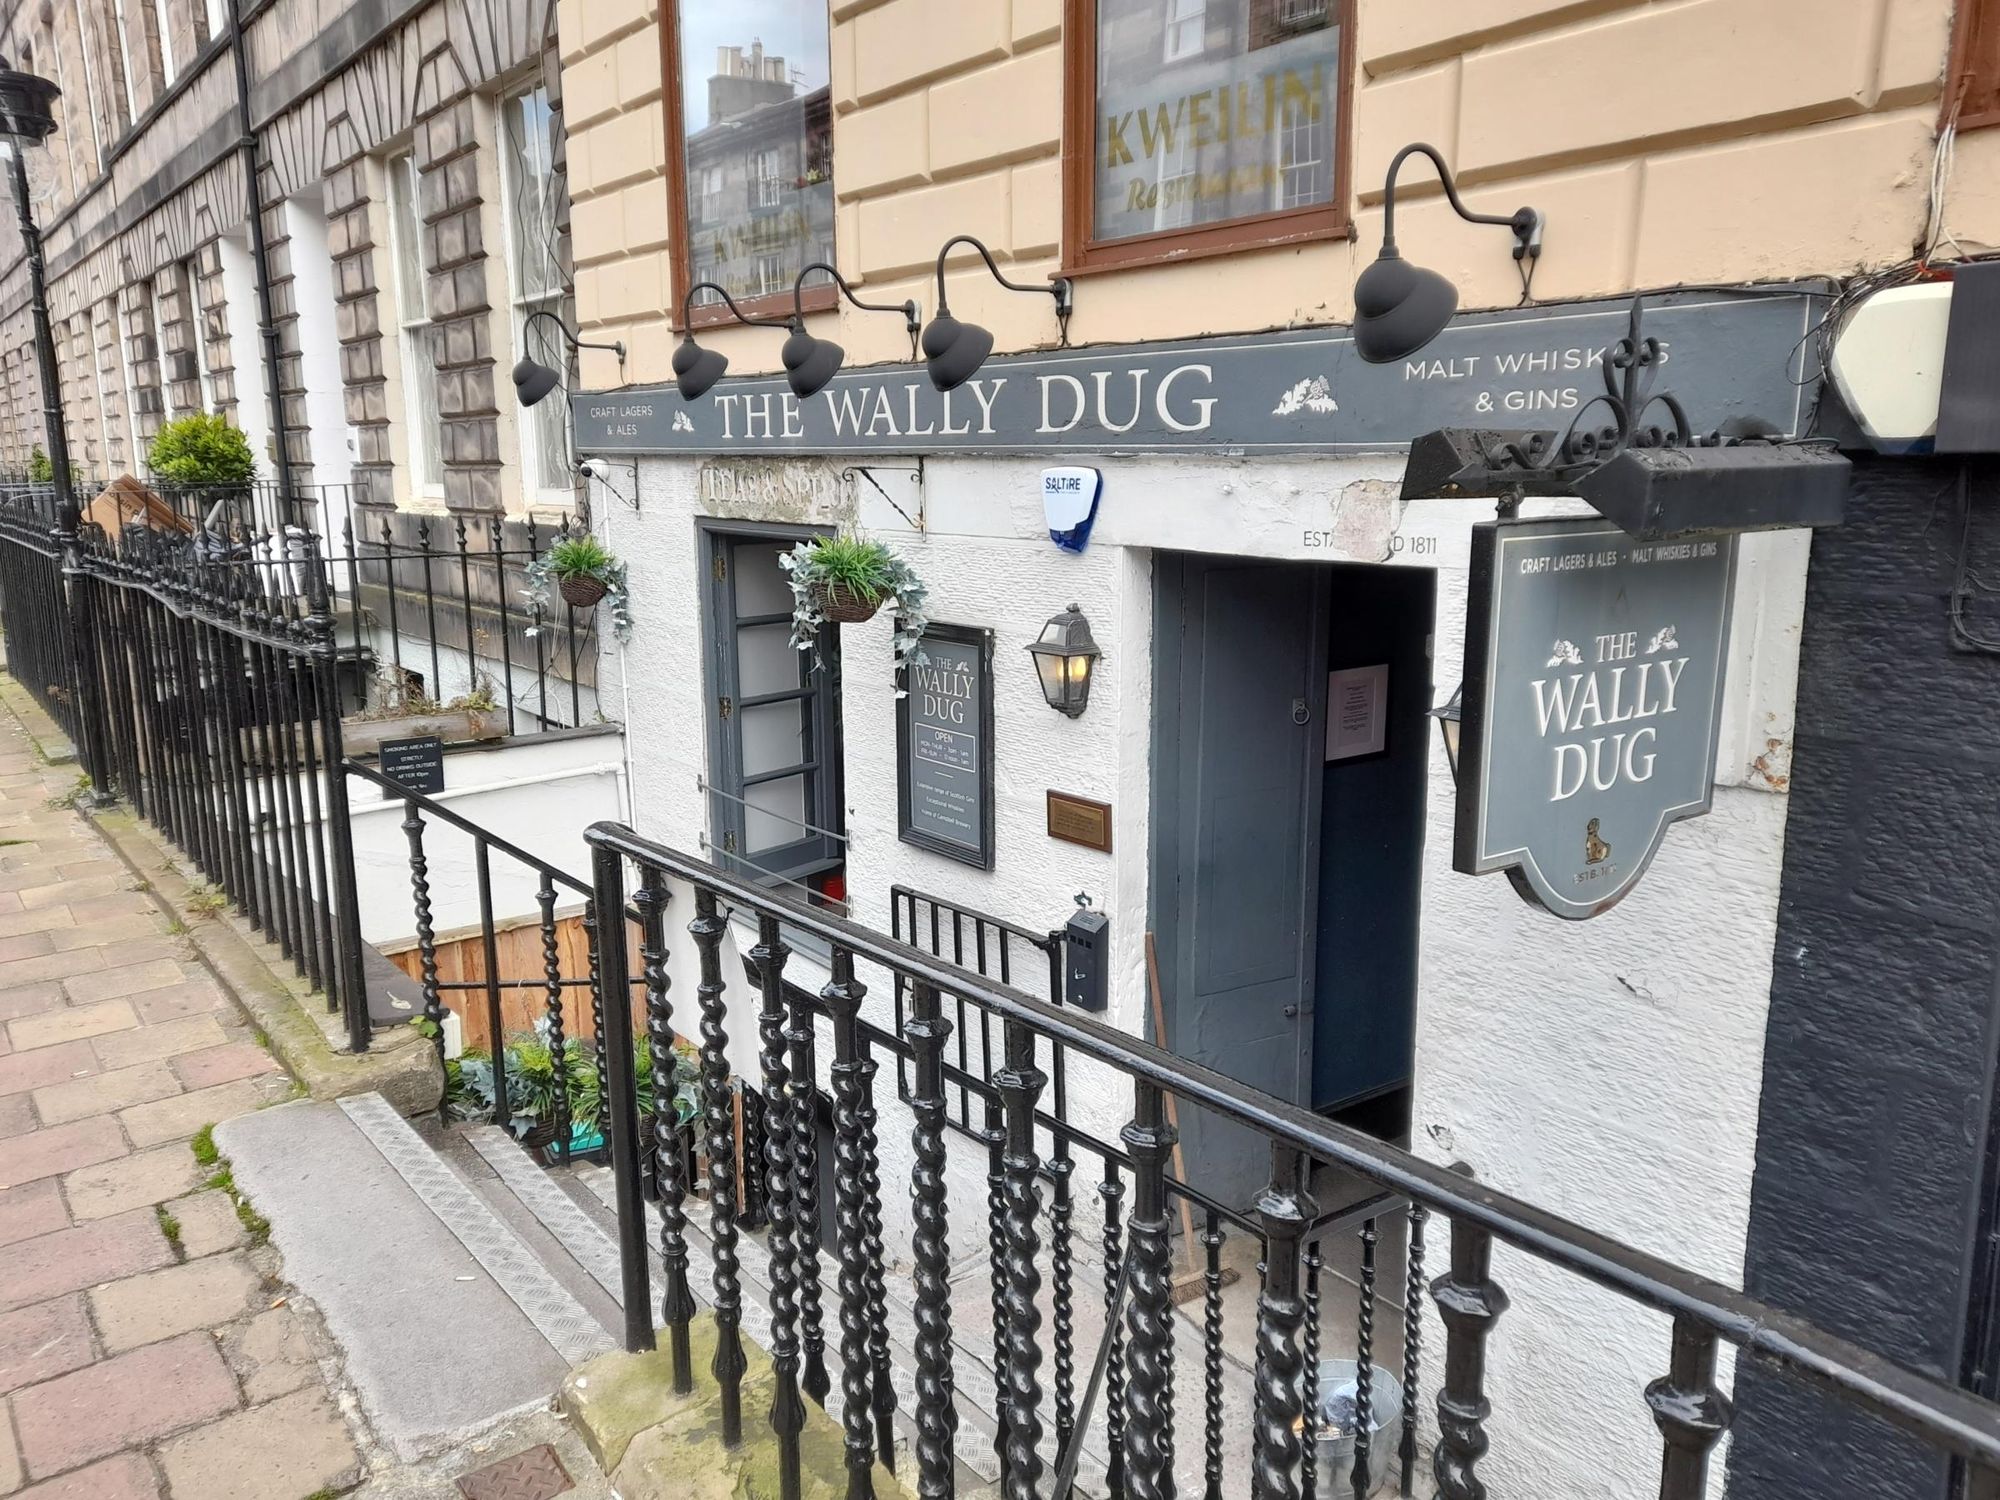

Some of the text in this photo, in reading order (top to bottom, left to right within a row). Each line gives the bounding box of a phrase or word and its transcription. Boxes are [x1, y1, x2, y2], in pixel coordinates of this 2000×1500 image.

[1107, 61, 1323, 168] KWEILIN
[1405, 342, 1671, 380] MALT WHISKS
[590, 405, 653, 418] CRAFT LAGERS
[714, 363, 1219, 439] THE WALLY DUG
[1474, 386, 1579, 412] & GINS
[607, 423, 638, 436] & ALES
[1411, 536, 1437, 554] 1811
[1520, 557, 1551, 574] CRAFT
[1553, 553, 1585, 571] LAGERS
[1588, 554, 1594, 568] &
[1595, 550, 1617, 567] ALES
[1632, 548, 1653, 563] MALT
[1656, 543, 1690, 561] WHISKIES
[1700, 542, 1717, 556] GINS
[1595, 631, 1638, 663] THE
[935, 656, 952, 671] THE
[915, 664, 975, 699] WALLY
[1530, 656, 1690, 737] WALLY
[923, 693, 965, 725] DUG
[934, 731, 953, 744] OPEN
[1549, 727, 1657, 802] DUG
